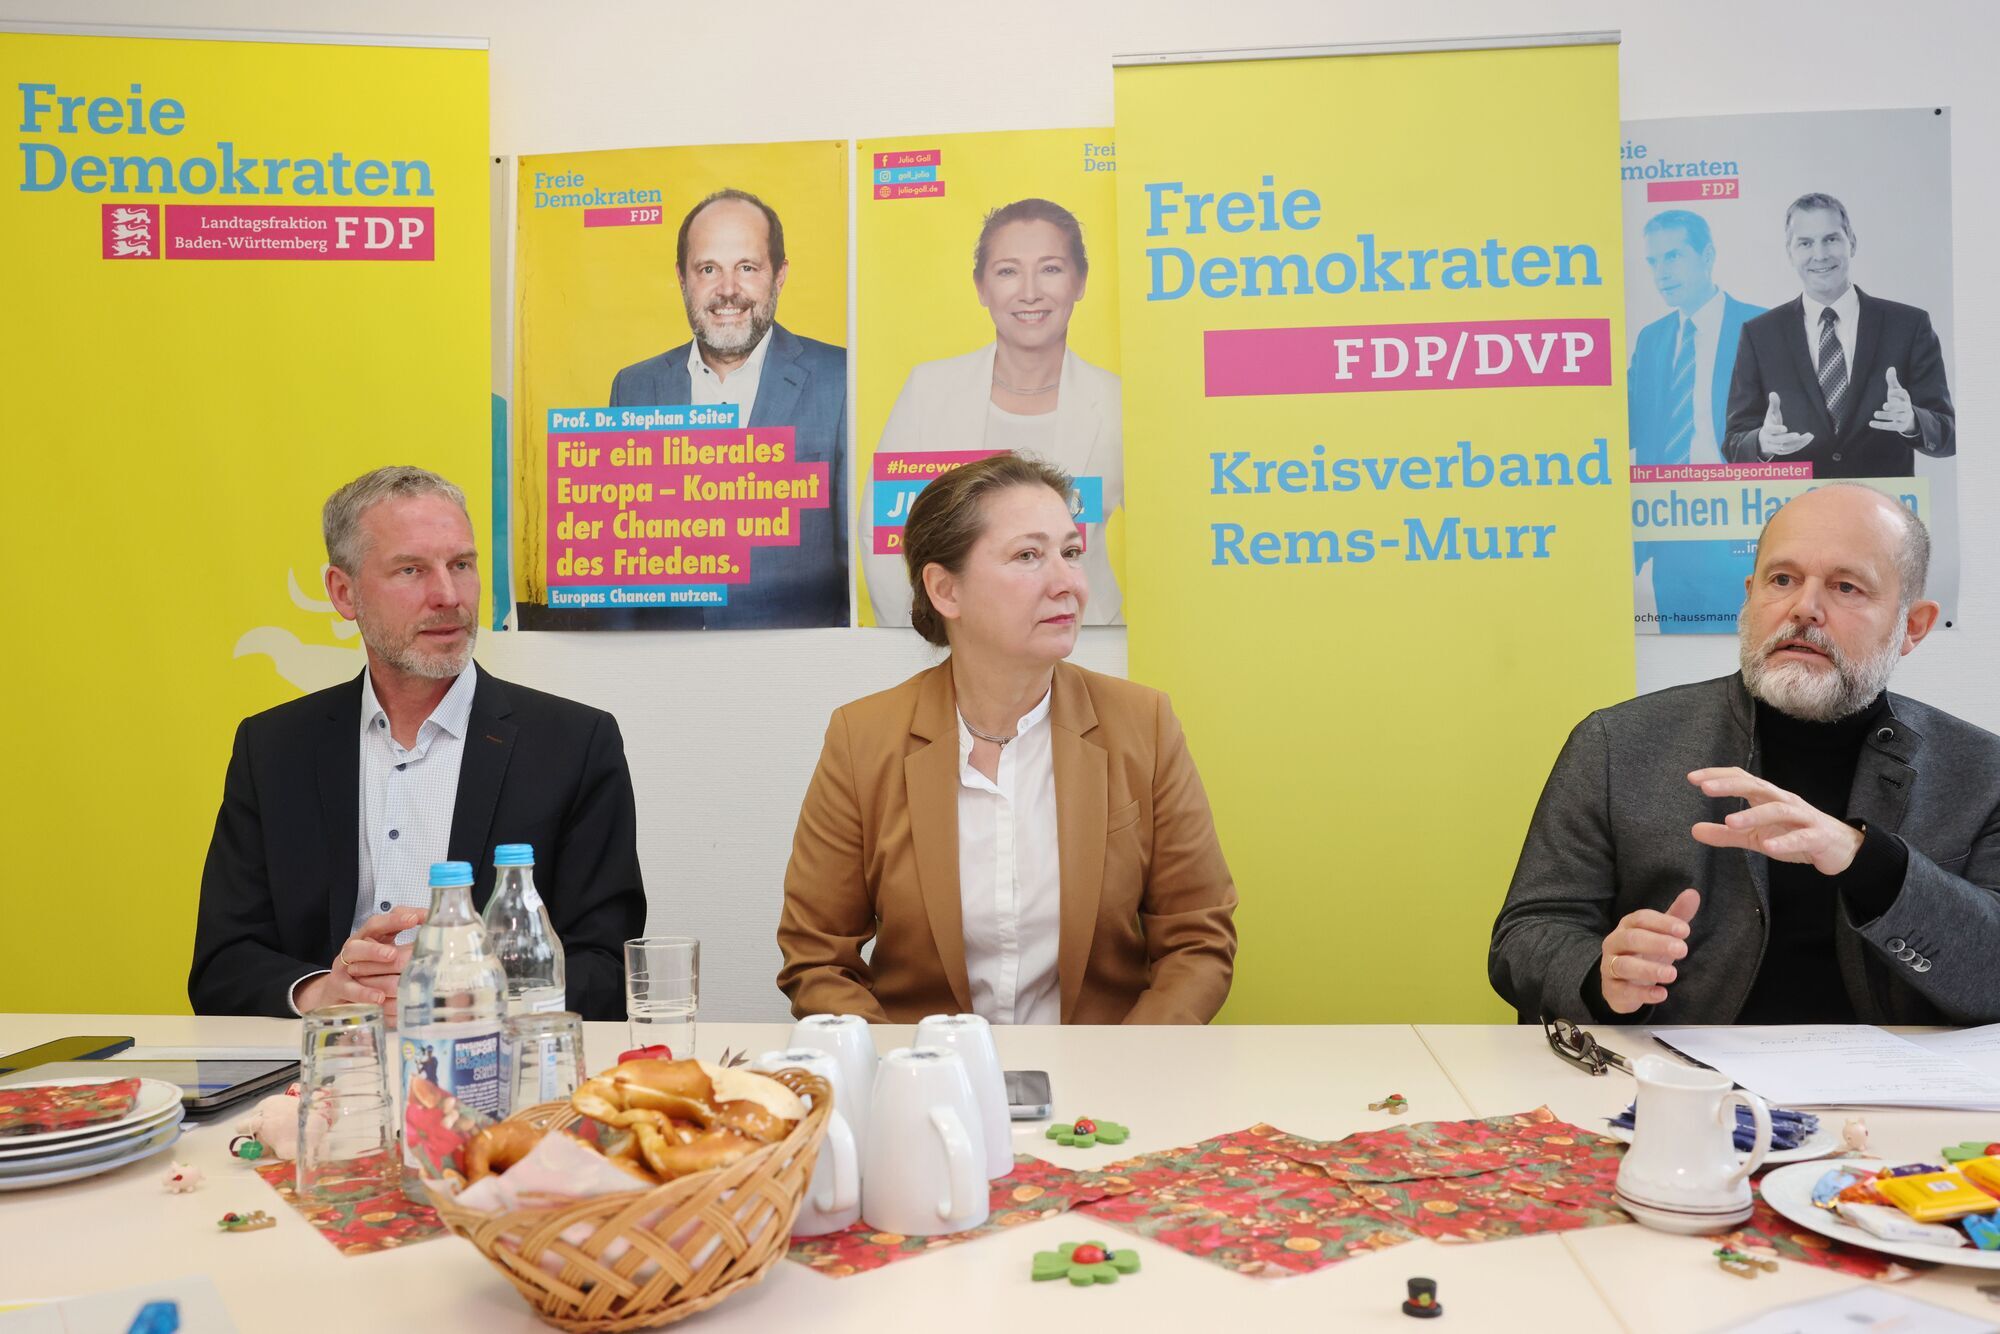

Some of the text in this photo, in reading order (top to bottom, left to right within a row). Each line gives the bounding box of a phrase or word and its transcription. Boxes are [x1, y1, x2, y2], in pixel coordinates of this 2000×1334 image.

[18, 83, 185, 135] Freie
[899, 154, 931, 164] Julia Goll
[1084, 142, 1116, 156] Frei
[1620, 140, 1647, 159] eie
[19, 142, 435, 196] Demokraten
[534, 170, 584, 189] Freie
[1620, 159, 1739, 180] mokraten
[534, 188, 662, 208] Demokraten
[1702, 183, 1735, 196] FDP
[630, 210, 660, 222] FDP
[1145, 175, 1321, 236] Freie
[200, 216, 328, 232] Landtagsfraktion
[335, 217, 425, 249] FDP
[175, 236, 328, 253] Baden-Württemberg
[1146, 234, 1602, 301] Demokraten
[1334, 331, 1594, 381] FDP/DVP
[553, 410, 734, 430] Prof. Dr. Stephan Seiter
[557, 434, 785, 467] Für ein liberales
[1210, 439, 1612, 495] Kreisverband
[1633, 465, 1809, 480] Ihr Landtagsabgeordneter
[557, 478, 653, 509] Europa
[683, 472, 820, 501] Kontinent
[1632, 489, 1728, 527] ochen
[557, 507, 789, 540] der Chancen und
[1211, 517, 1556, 566] Rems-Murr
[556, 546, 739, 576] des Friedens.
[552, 589, 722, 606] Europas Chancen nutzen.
[1634, 613, 1738, 622] ochen-haussmann
